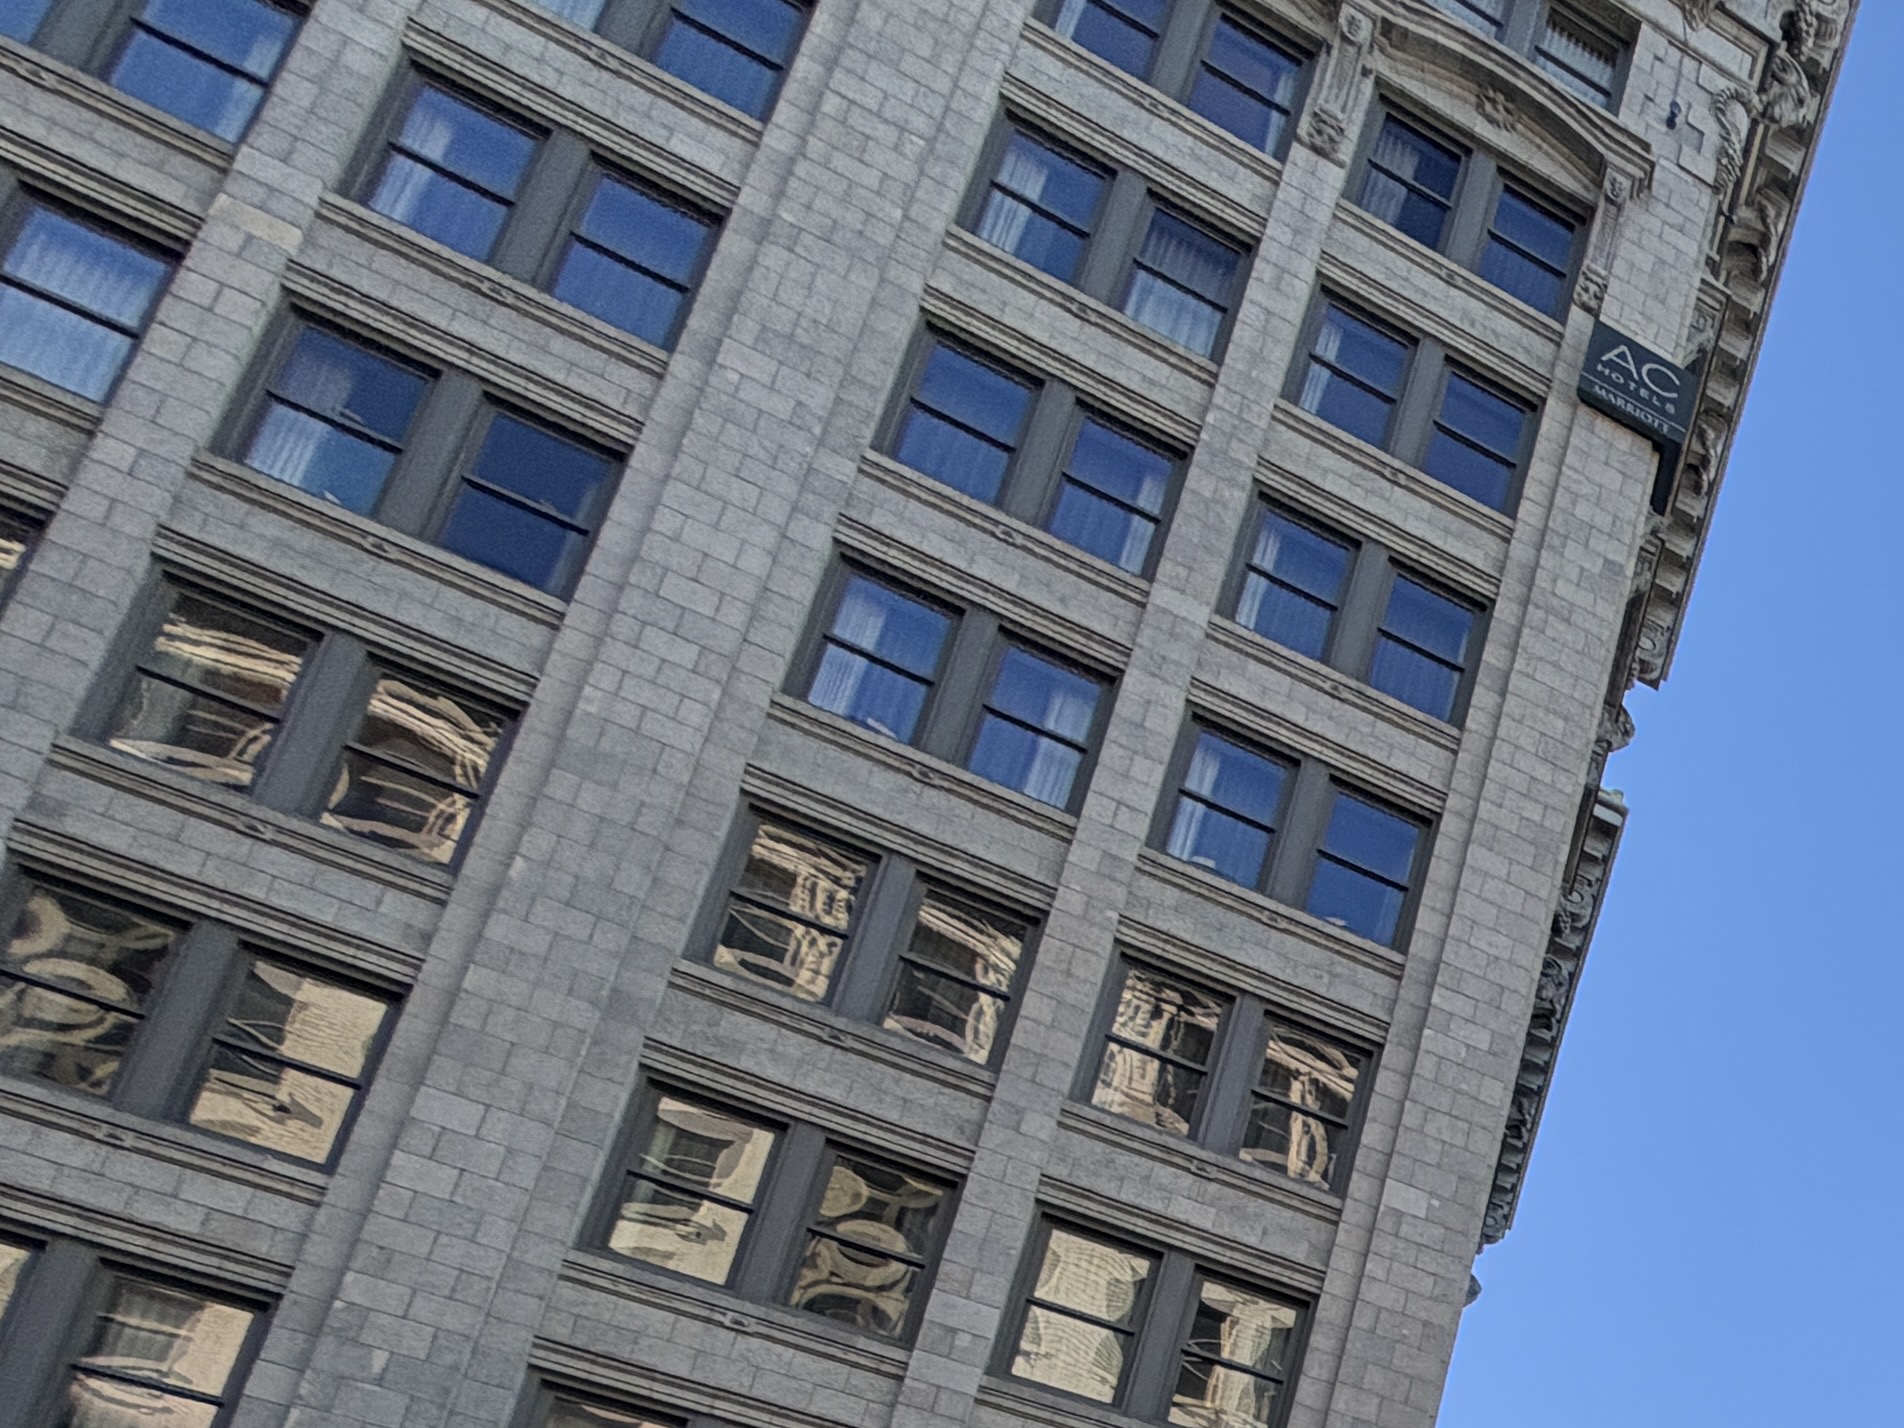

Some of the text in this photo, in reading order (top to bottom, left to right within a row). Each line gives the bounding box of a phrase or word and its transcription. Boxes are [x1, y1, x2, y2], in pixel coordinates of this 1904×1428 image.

[1596, 363, 1676, 415] HOTELS
[1601, 345, 1680, 398] AC
[1592, 384, 1670, 434] MARRIOTT
